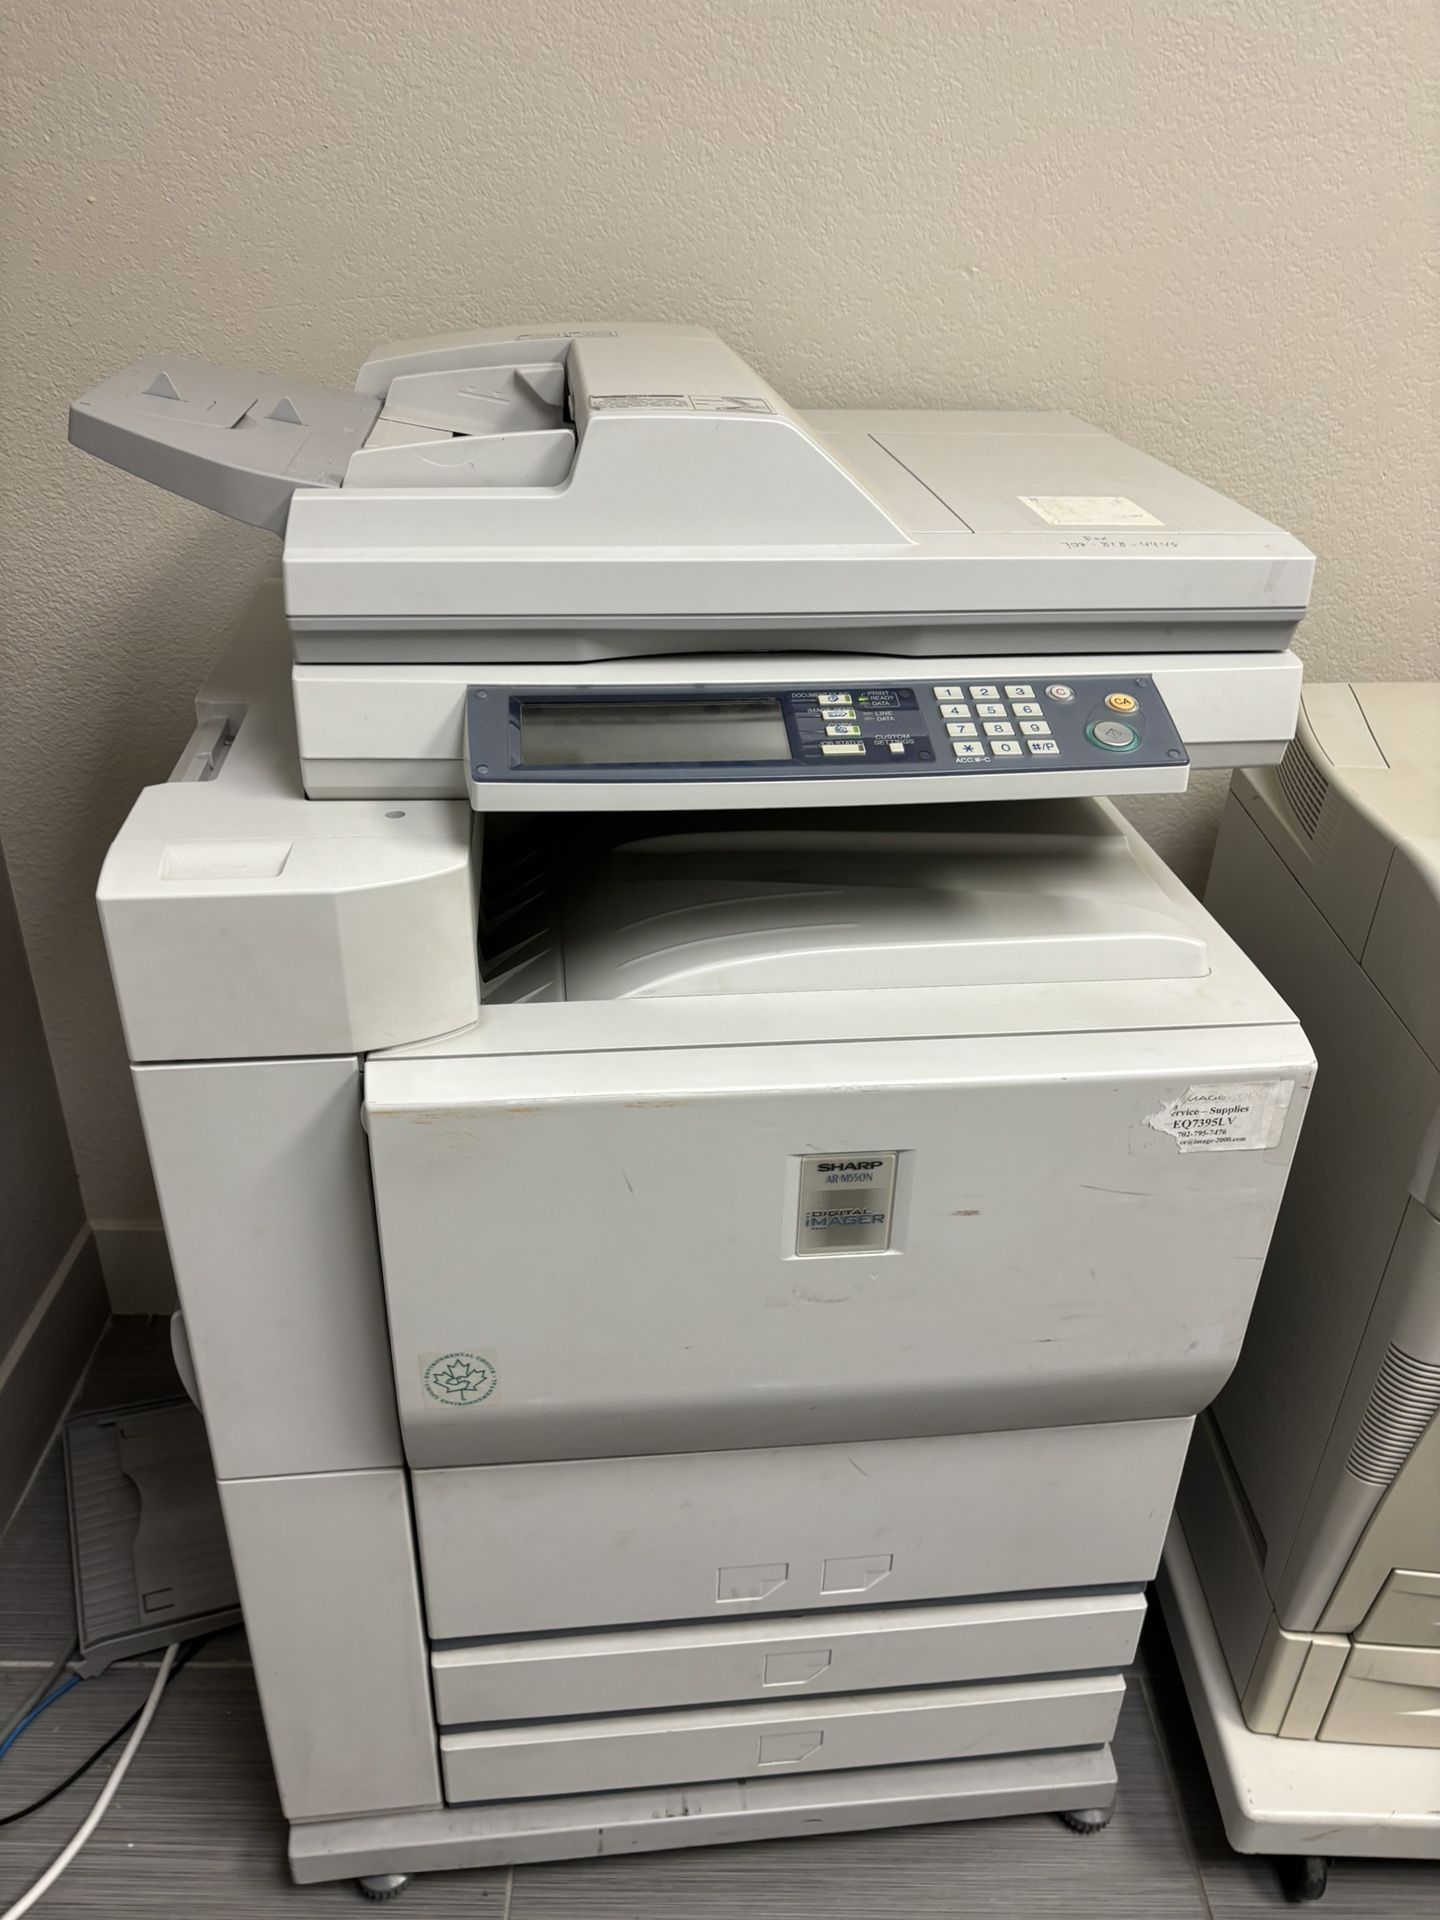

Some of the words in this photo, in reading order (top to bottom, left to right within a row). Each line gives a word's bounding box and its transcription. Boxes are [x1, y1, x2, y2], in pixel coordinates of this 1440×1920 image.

[945, 688, 952, 696] 1
[980, 688, 988, 696] 2
[1015, 687, 1024, 696] 3
[1055, 688, 1066, 696] C
[1114, 696, 1132, 707] CA
[950, 706, 959, 715] 4
[987, 706, 996, 715] 5
[1023, 705, 1032, 714] 6
[956, 725, 965, 734] 7
[994, 724, 1003, 733] 8
[1030, 723, 1040, 732] 9
[1001, 743, 1010, 752] 0
[1031, 742, 1054, 752] #/P
[1209, 1105, 1250, 1116] Supplies
[1177, 1128, 1227, 1138] 702-795-7476
[817, 1160, 883, 1172] SHARP
[826, 1173, 873, 1183] AR-M550N
[812, 1208, 872, 1216] DIGITAL
